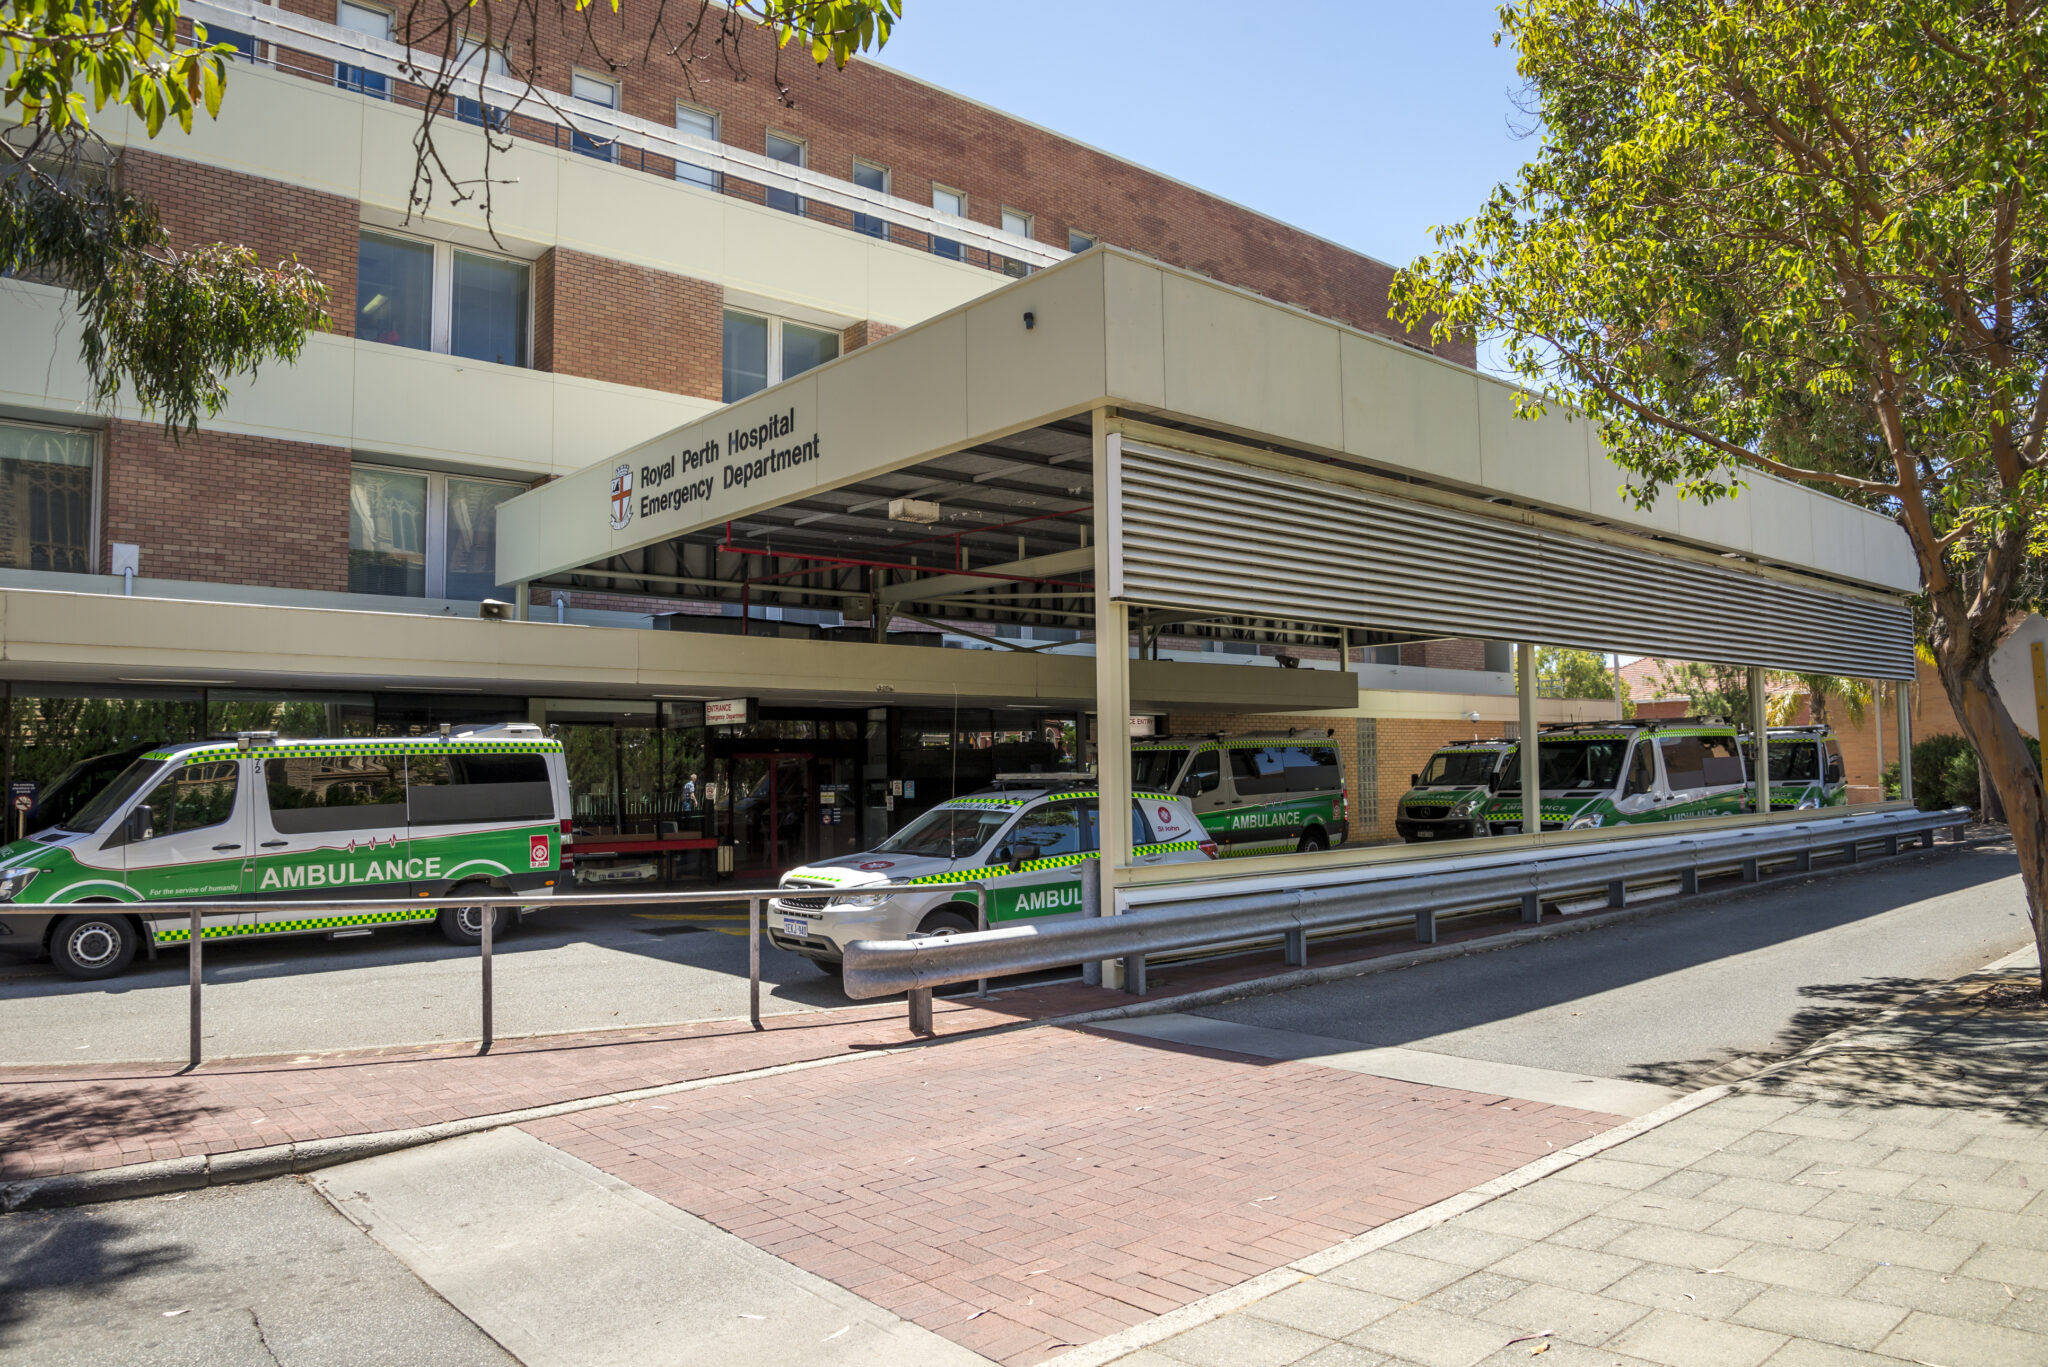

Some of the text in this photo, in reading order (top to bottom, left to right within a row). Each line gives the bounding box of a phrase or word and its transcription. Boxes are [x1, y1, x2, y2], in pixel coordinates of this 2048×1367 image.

[641, 407, 794, 489] Royal Perth Hospital
[640, 433, 820, 518] Emergency Department
[707, 703, 732, 713] ENTRANCE
[707, 714, 725, 722] Emergency
[726, 712, 746, 721] Department
[254, 758, 261, 774] 72
[1232, 811, 1300, 830] AMBULANCE
[259, 857, 441, 890] AMBULANCE
[150, 888, 161, 896] For
[200, 885, 208, 893] of
[208, 884, 239, 892] humanity
